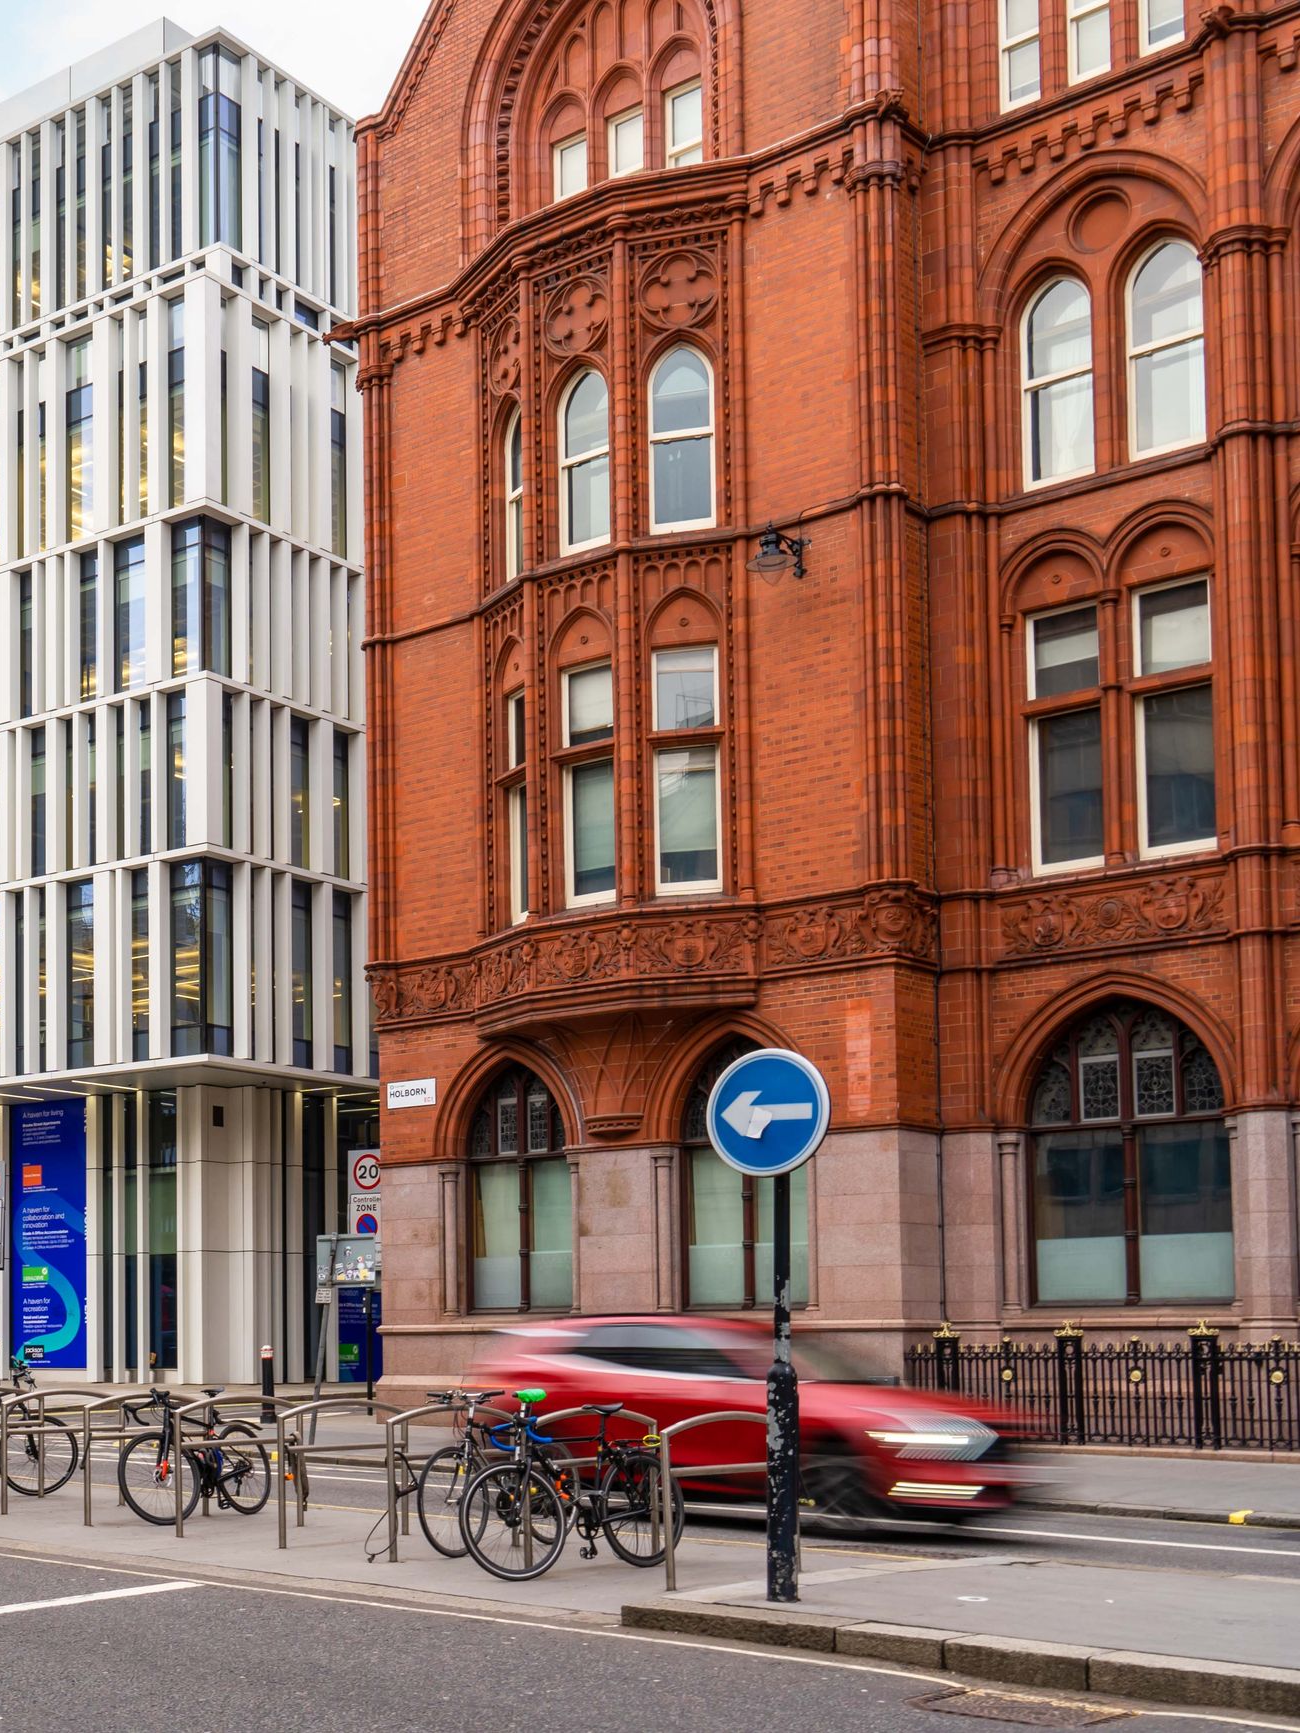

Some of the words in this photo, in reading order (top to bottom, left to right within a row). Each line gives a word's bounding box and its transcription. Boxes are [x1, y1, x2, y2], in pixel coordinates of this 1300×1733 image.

[389, 1087, 427, 1098] HOLBORN
[358, 1164, 379, 1180] 20
[356, 1204, 377, 1212] ZONE
